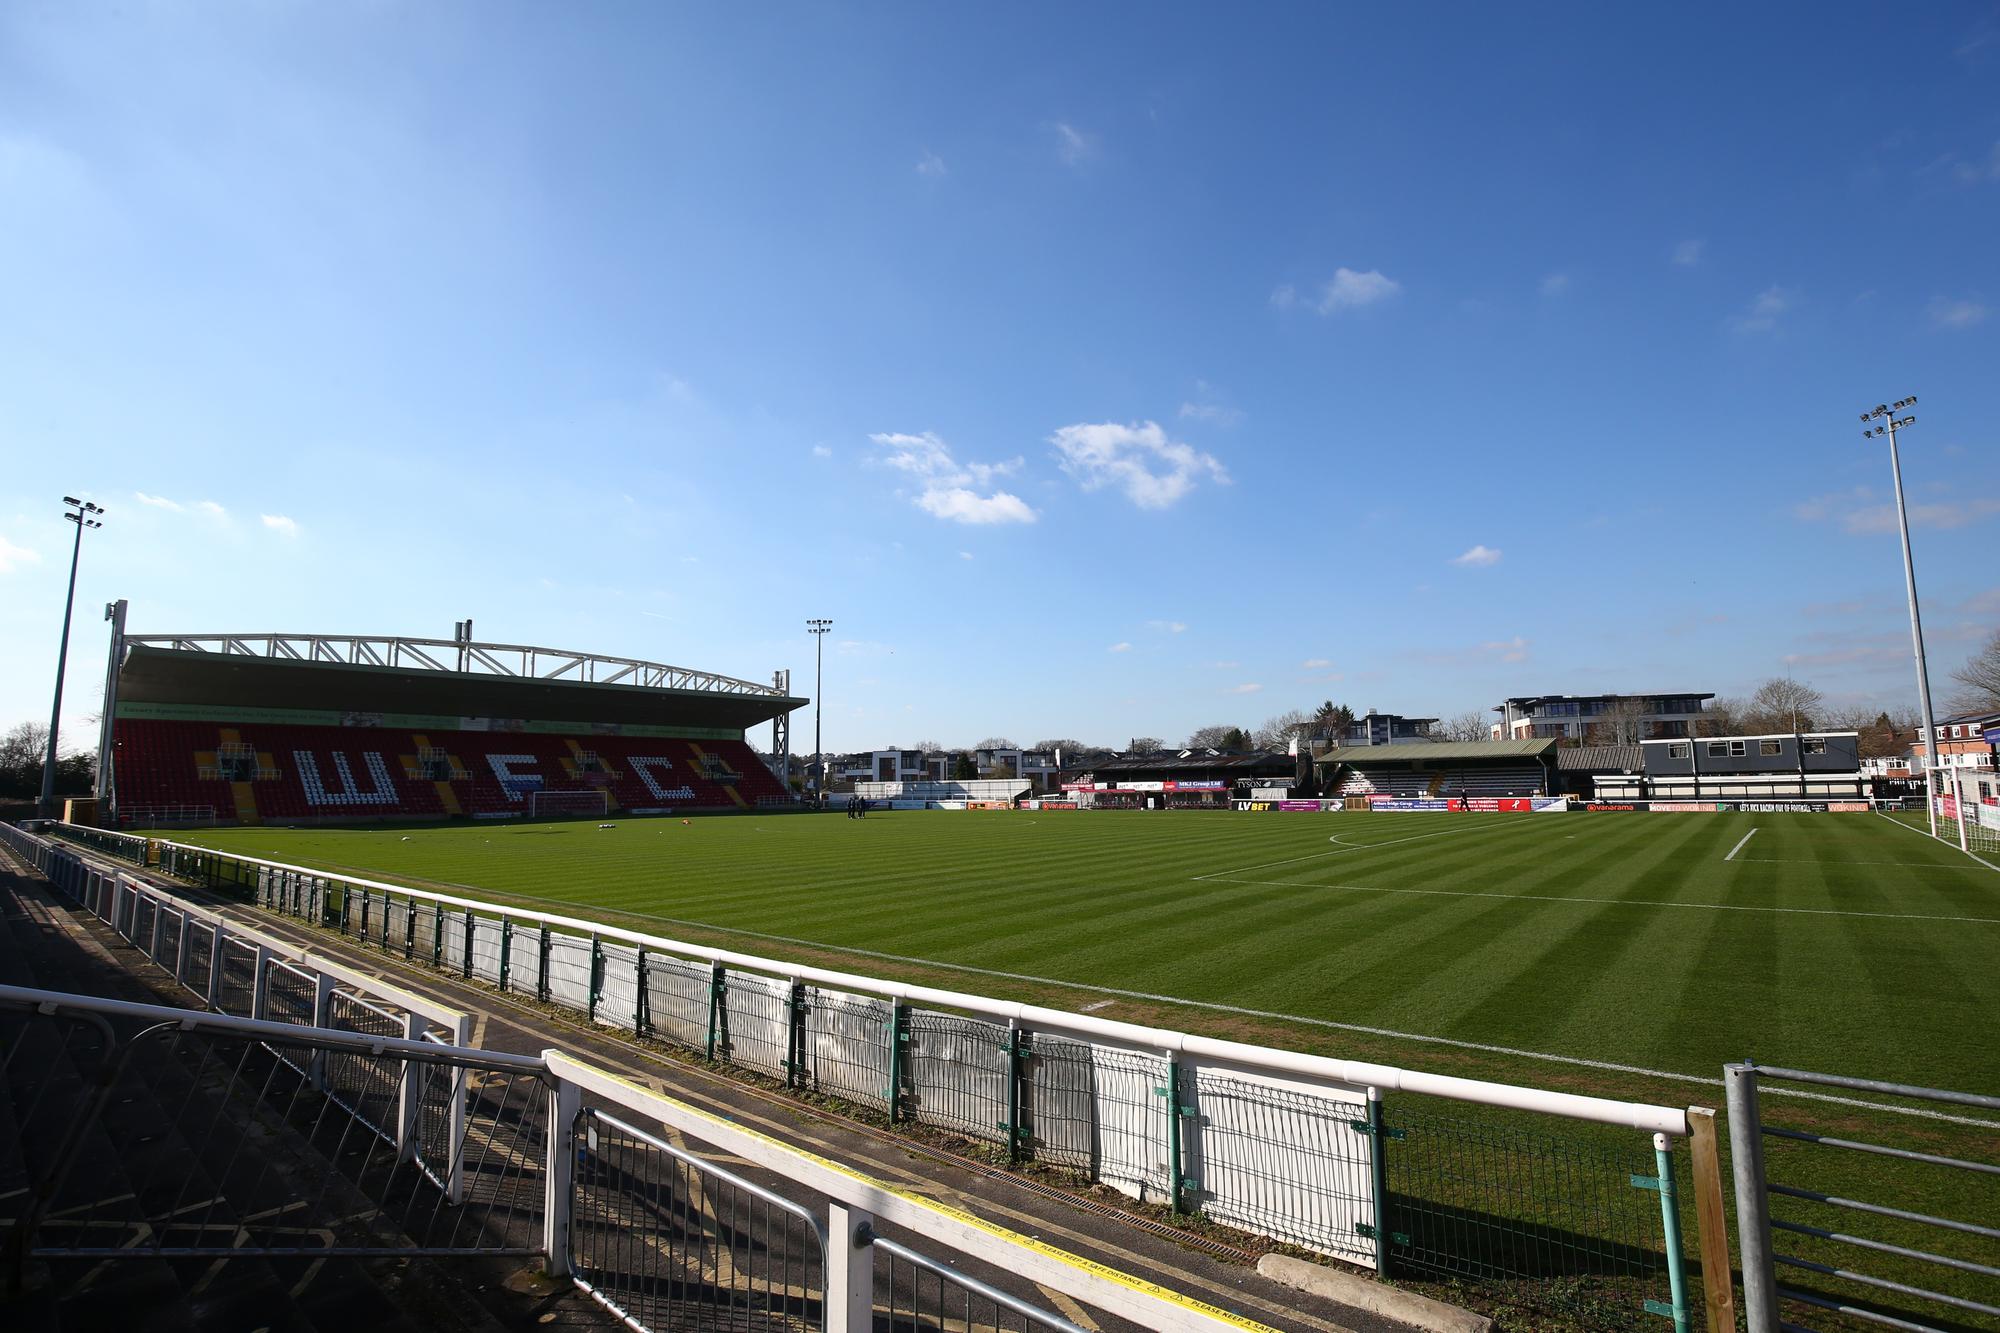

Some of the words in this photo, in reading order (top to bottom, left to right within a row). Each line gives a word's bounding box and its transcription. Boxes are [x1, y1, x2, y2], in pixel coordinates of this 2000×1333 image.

[923, 1199, 941, 1208] PLEASE
[942, 1206, 956, 1214] KEEP
[975, 1219, 1003, 1232] DISTANCE
[1040, 1244, 1065, 1256] PLEASE
[1065, 1254, 1082, 1263] KEEP
[1089, 1263, 1106, 1272] SAFE
[1107, 1270, 1142, 1285] DISTANCE
[1191, 1300, 1220, 1314] PLEASE
[1222, 1312, 1243, 1322] KEEP
